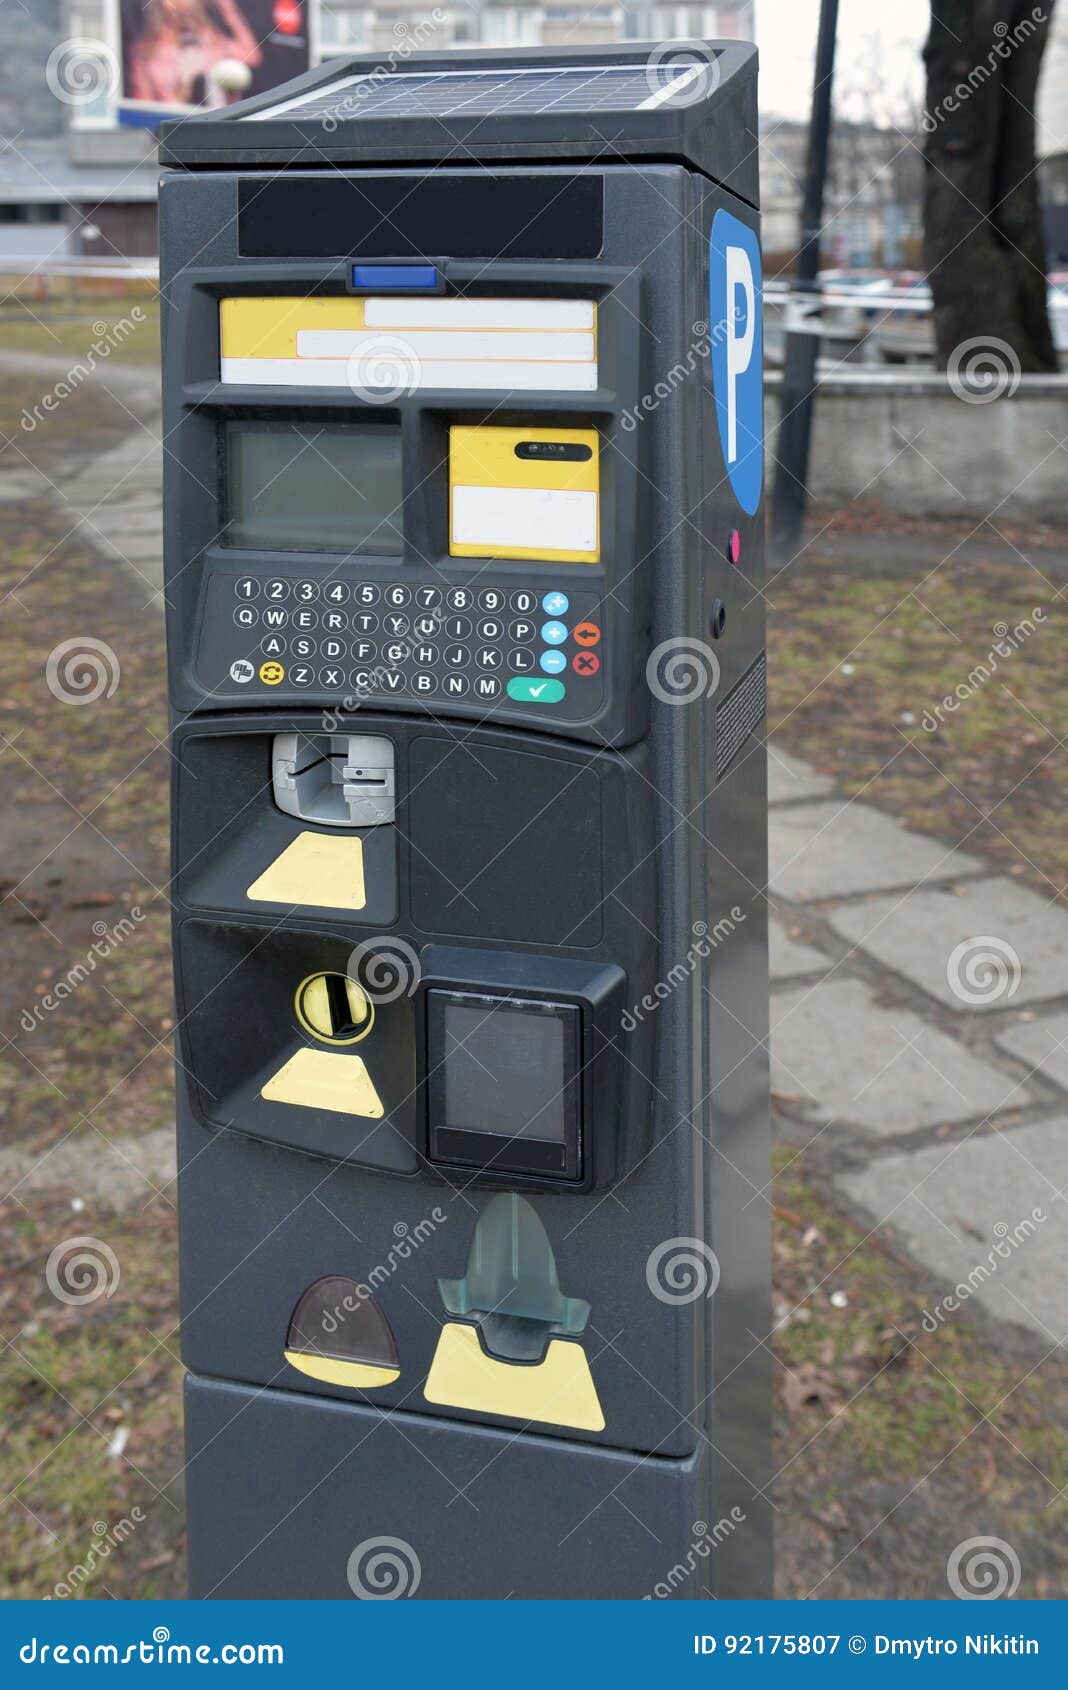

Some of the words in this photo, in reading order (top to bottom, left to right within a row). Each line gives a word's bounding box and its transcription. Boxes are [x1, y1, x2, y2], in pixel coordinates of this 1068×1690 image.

[726, 245, 756, 463] P
[271, 583, 283, 598] 2
[301, 584, 313, 599] 3
[330, 586, 343, 600] 4
[362, 587, 373, 602] 5
[392, 588, 404, 604] 6
[423, 590, 435, 605] 7
[454, 591, 466, 607] 8
[485, 593, 497, 608] 9
[517, 594, 529, 610] 0
[239, 610, 252, 623] Q
[267, 612, 284, 624] W
[300, 613, 311, 626] E
[329, 614, 342, 627] R
[360, 616, 372, 629] T
[390, 617, 402, 630] Y
[421, 620, 433, 633] U
[483, 623, 497, 636] O
[517, 625, 529, 637] P
[267, 639, 280, 652] A
[298, 641, 309, 654] S
[328, 643, 340, 655] D
[358, 644, 370, 657] F
[388, 646, 401, 659] G
[419, 648, 432, 661] H
[452, 650, 462, 663] J
[483, 651, 496, 665] K
[516, 653, 527, 667] L
[295, 669, 307, 682] Z
[325, 671, 338, 684] X
[356, 672, 368, 686] C
[386, 674, 400, 687] V
[418, 676, 431, 689] B
[450, 678, 462, 692] N
[480, 680, 495, 694] M
